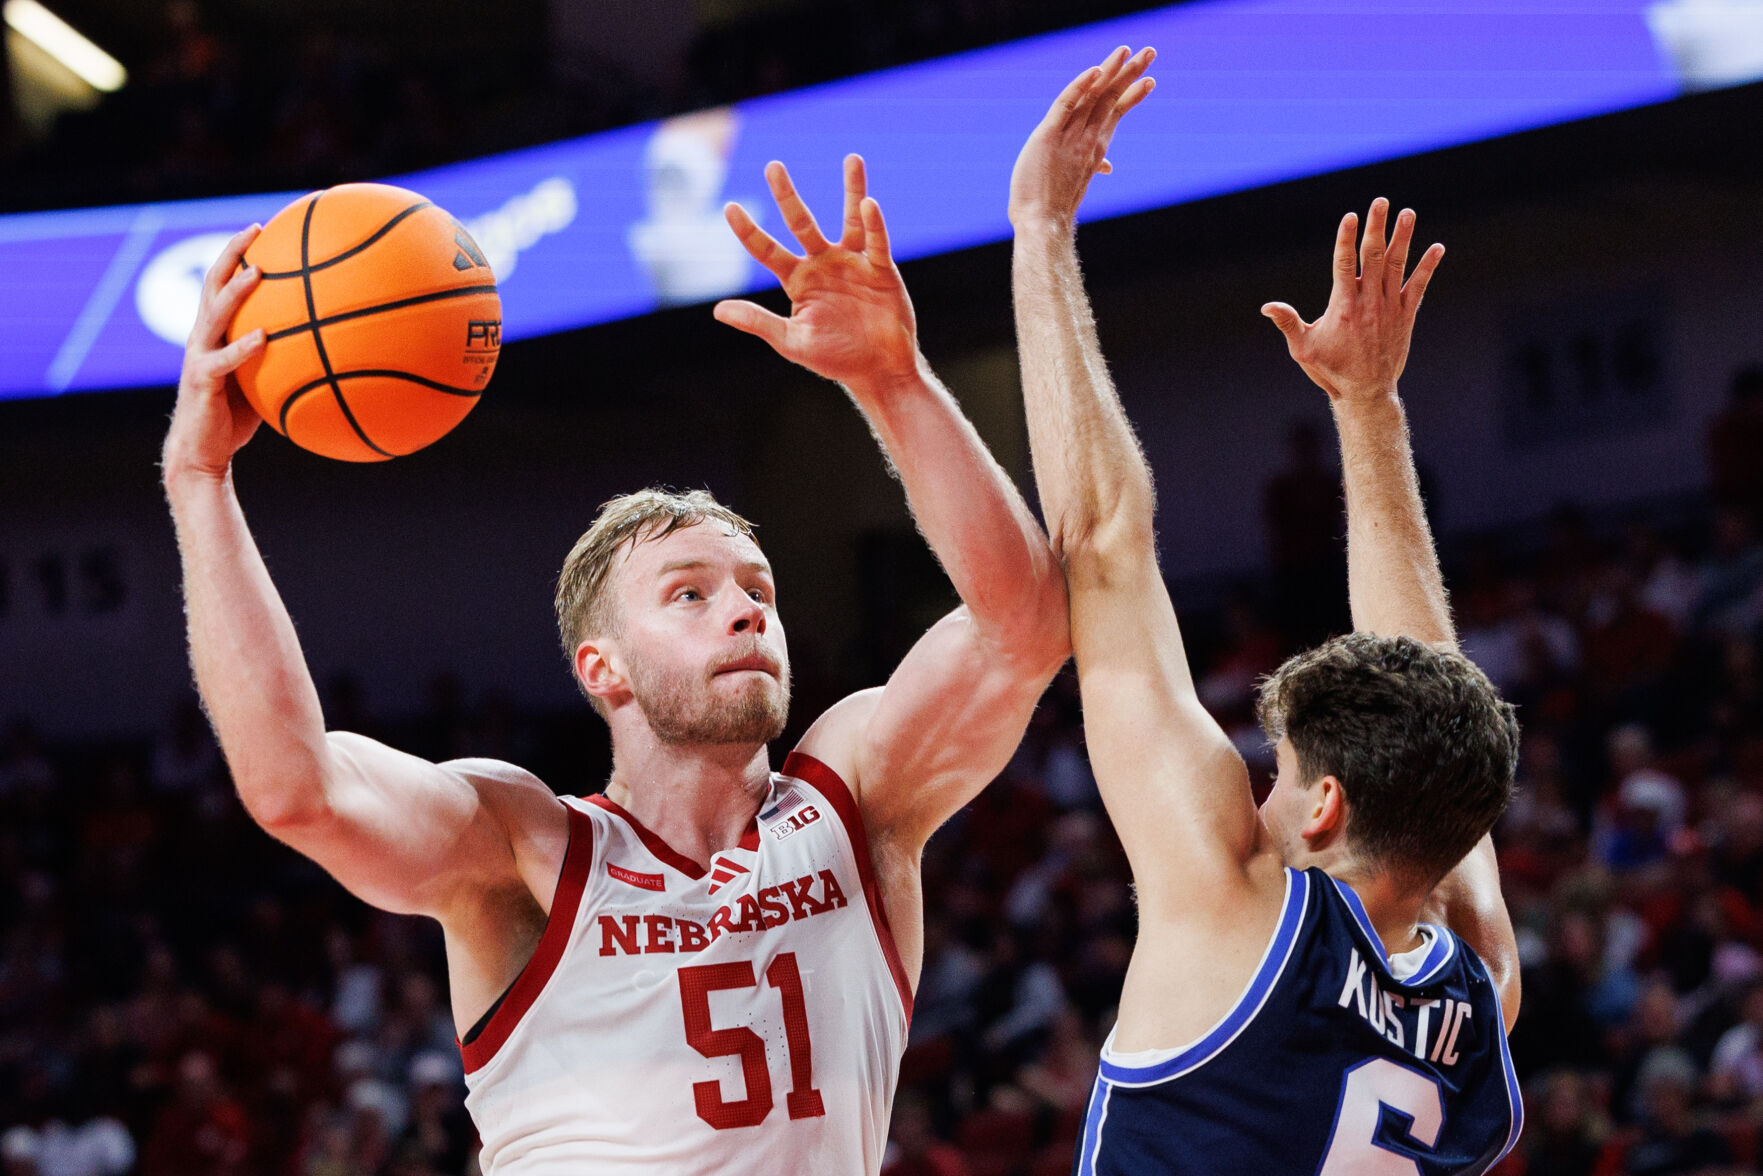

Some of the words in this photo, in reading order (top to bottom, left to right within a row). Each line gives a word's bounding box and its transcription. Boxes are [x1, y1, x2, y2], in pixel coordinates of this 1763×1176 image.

[466, 320, 501, 347] PR
[609, 867, 663, 888] GRADUATE
[598, 868, 848, 957] NEBRASKA
[677, 951, 826, 1131] 51
